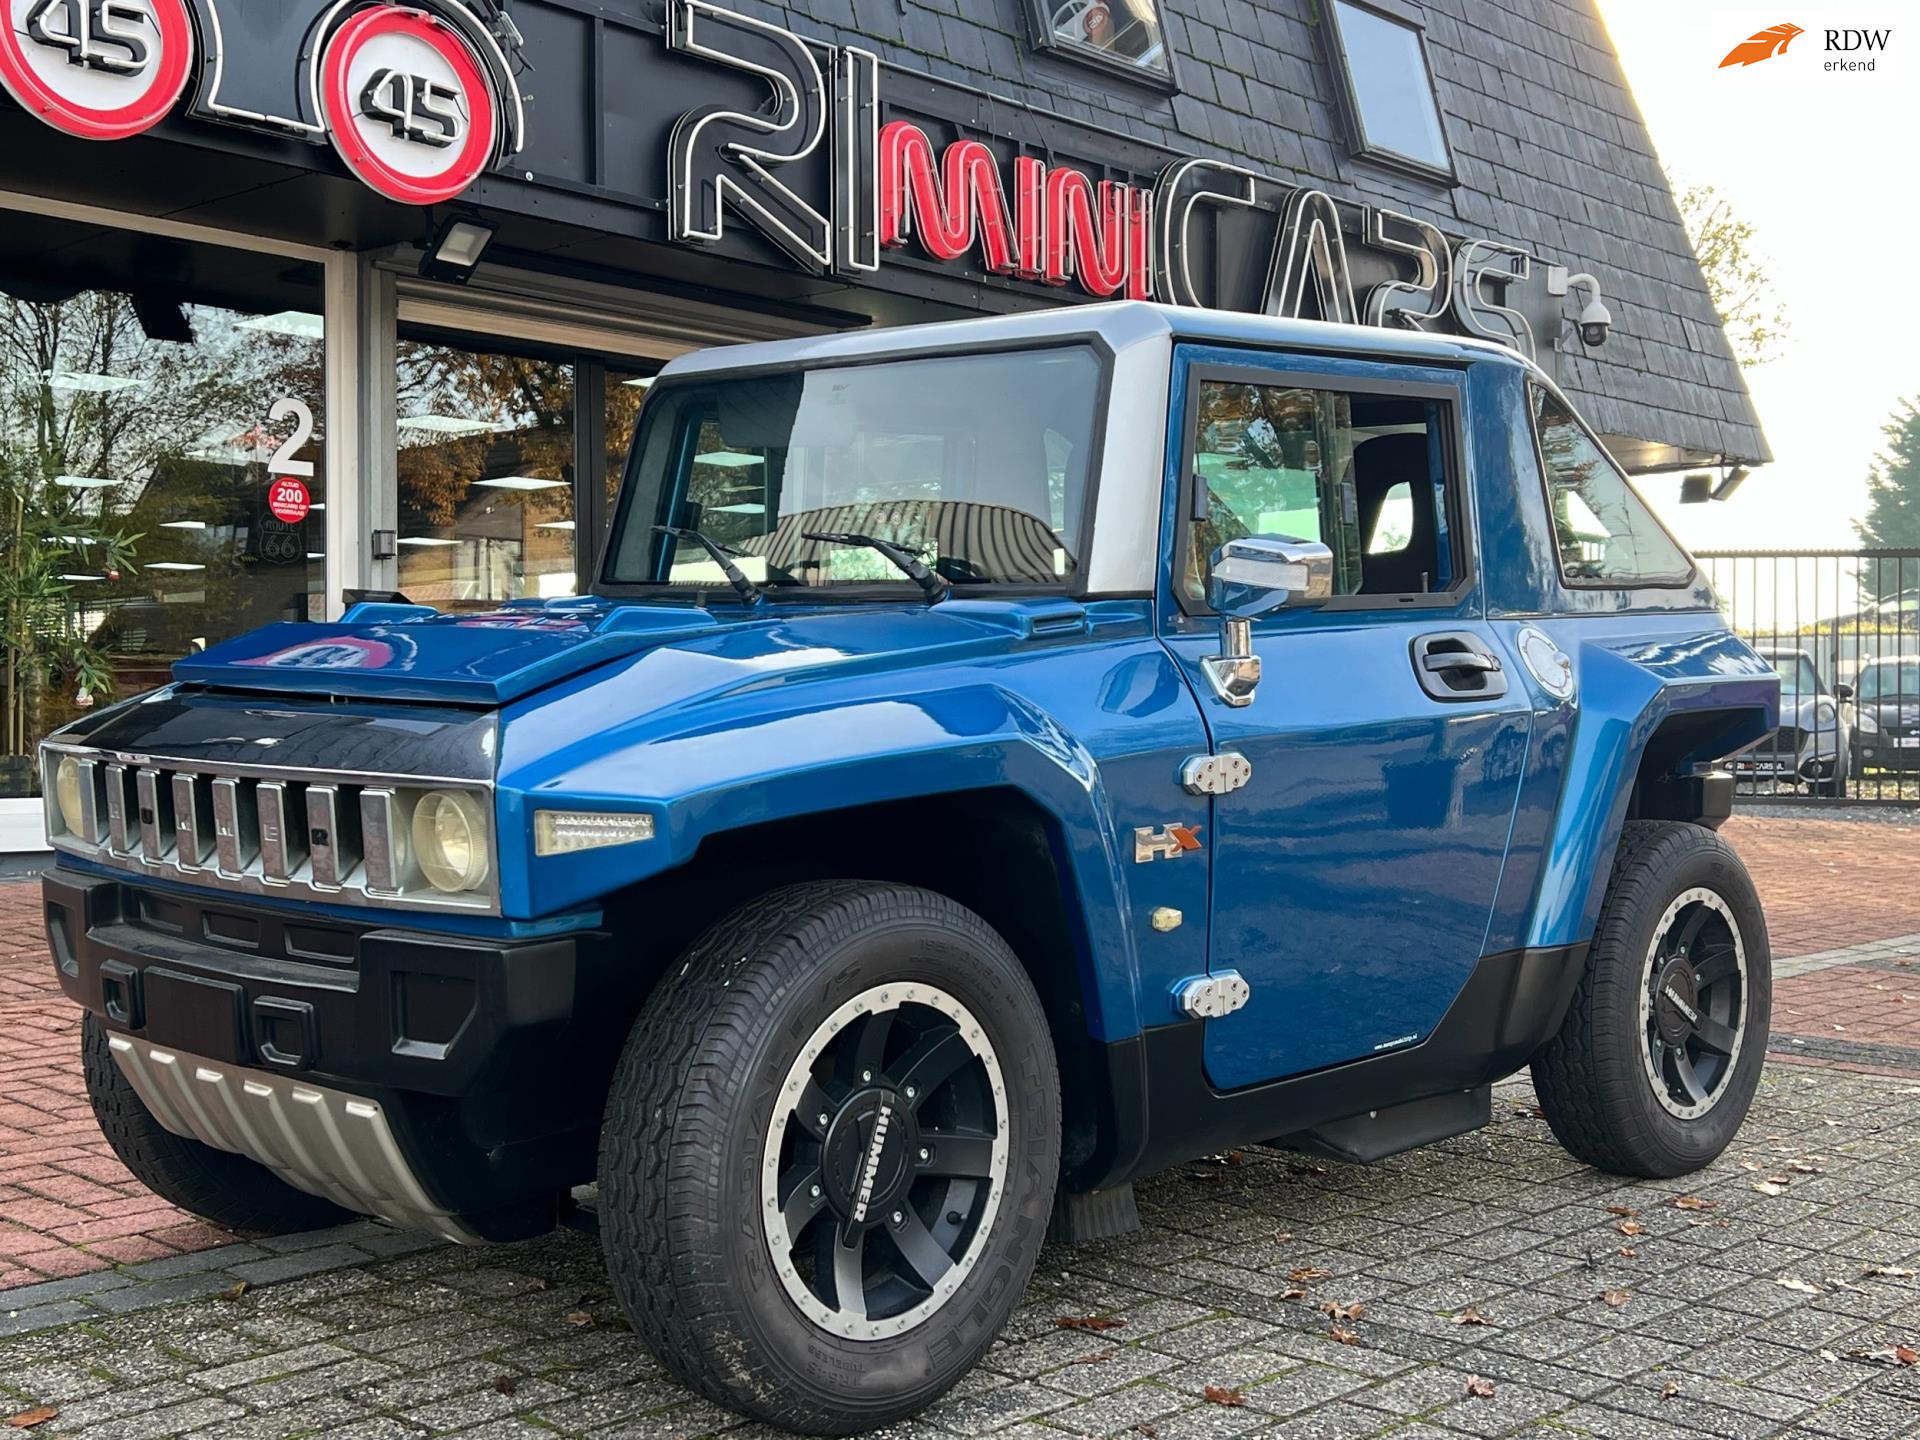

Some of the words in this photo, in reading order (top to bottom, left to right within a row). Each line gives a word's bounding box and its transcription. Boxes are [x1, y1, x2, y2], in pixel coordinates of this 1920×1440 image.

[26, 0, 151, 76] 45
[360, 68, 463, 149] 45
[268, 398, 313, 476] 2
[277, 488, 303, 503] 200
[265, 519, 296, 532] ROUTE
[265, 534, 296, 558] 66
[1664, 984, 1698, 1023] HUMMER
[853, 1105, 892, 1223] HUMMER
